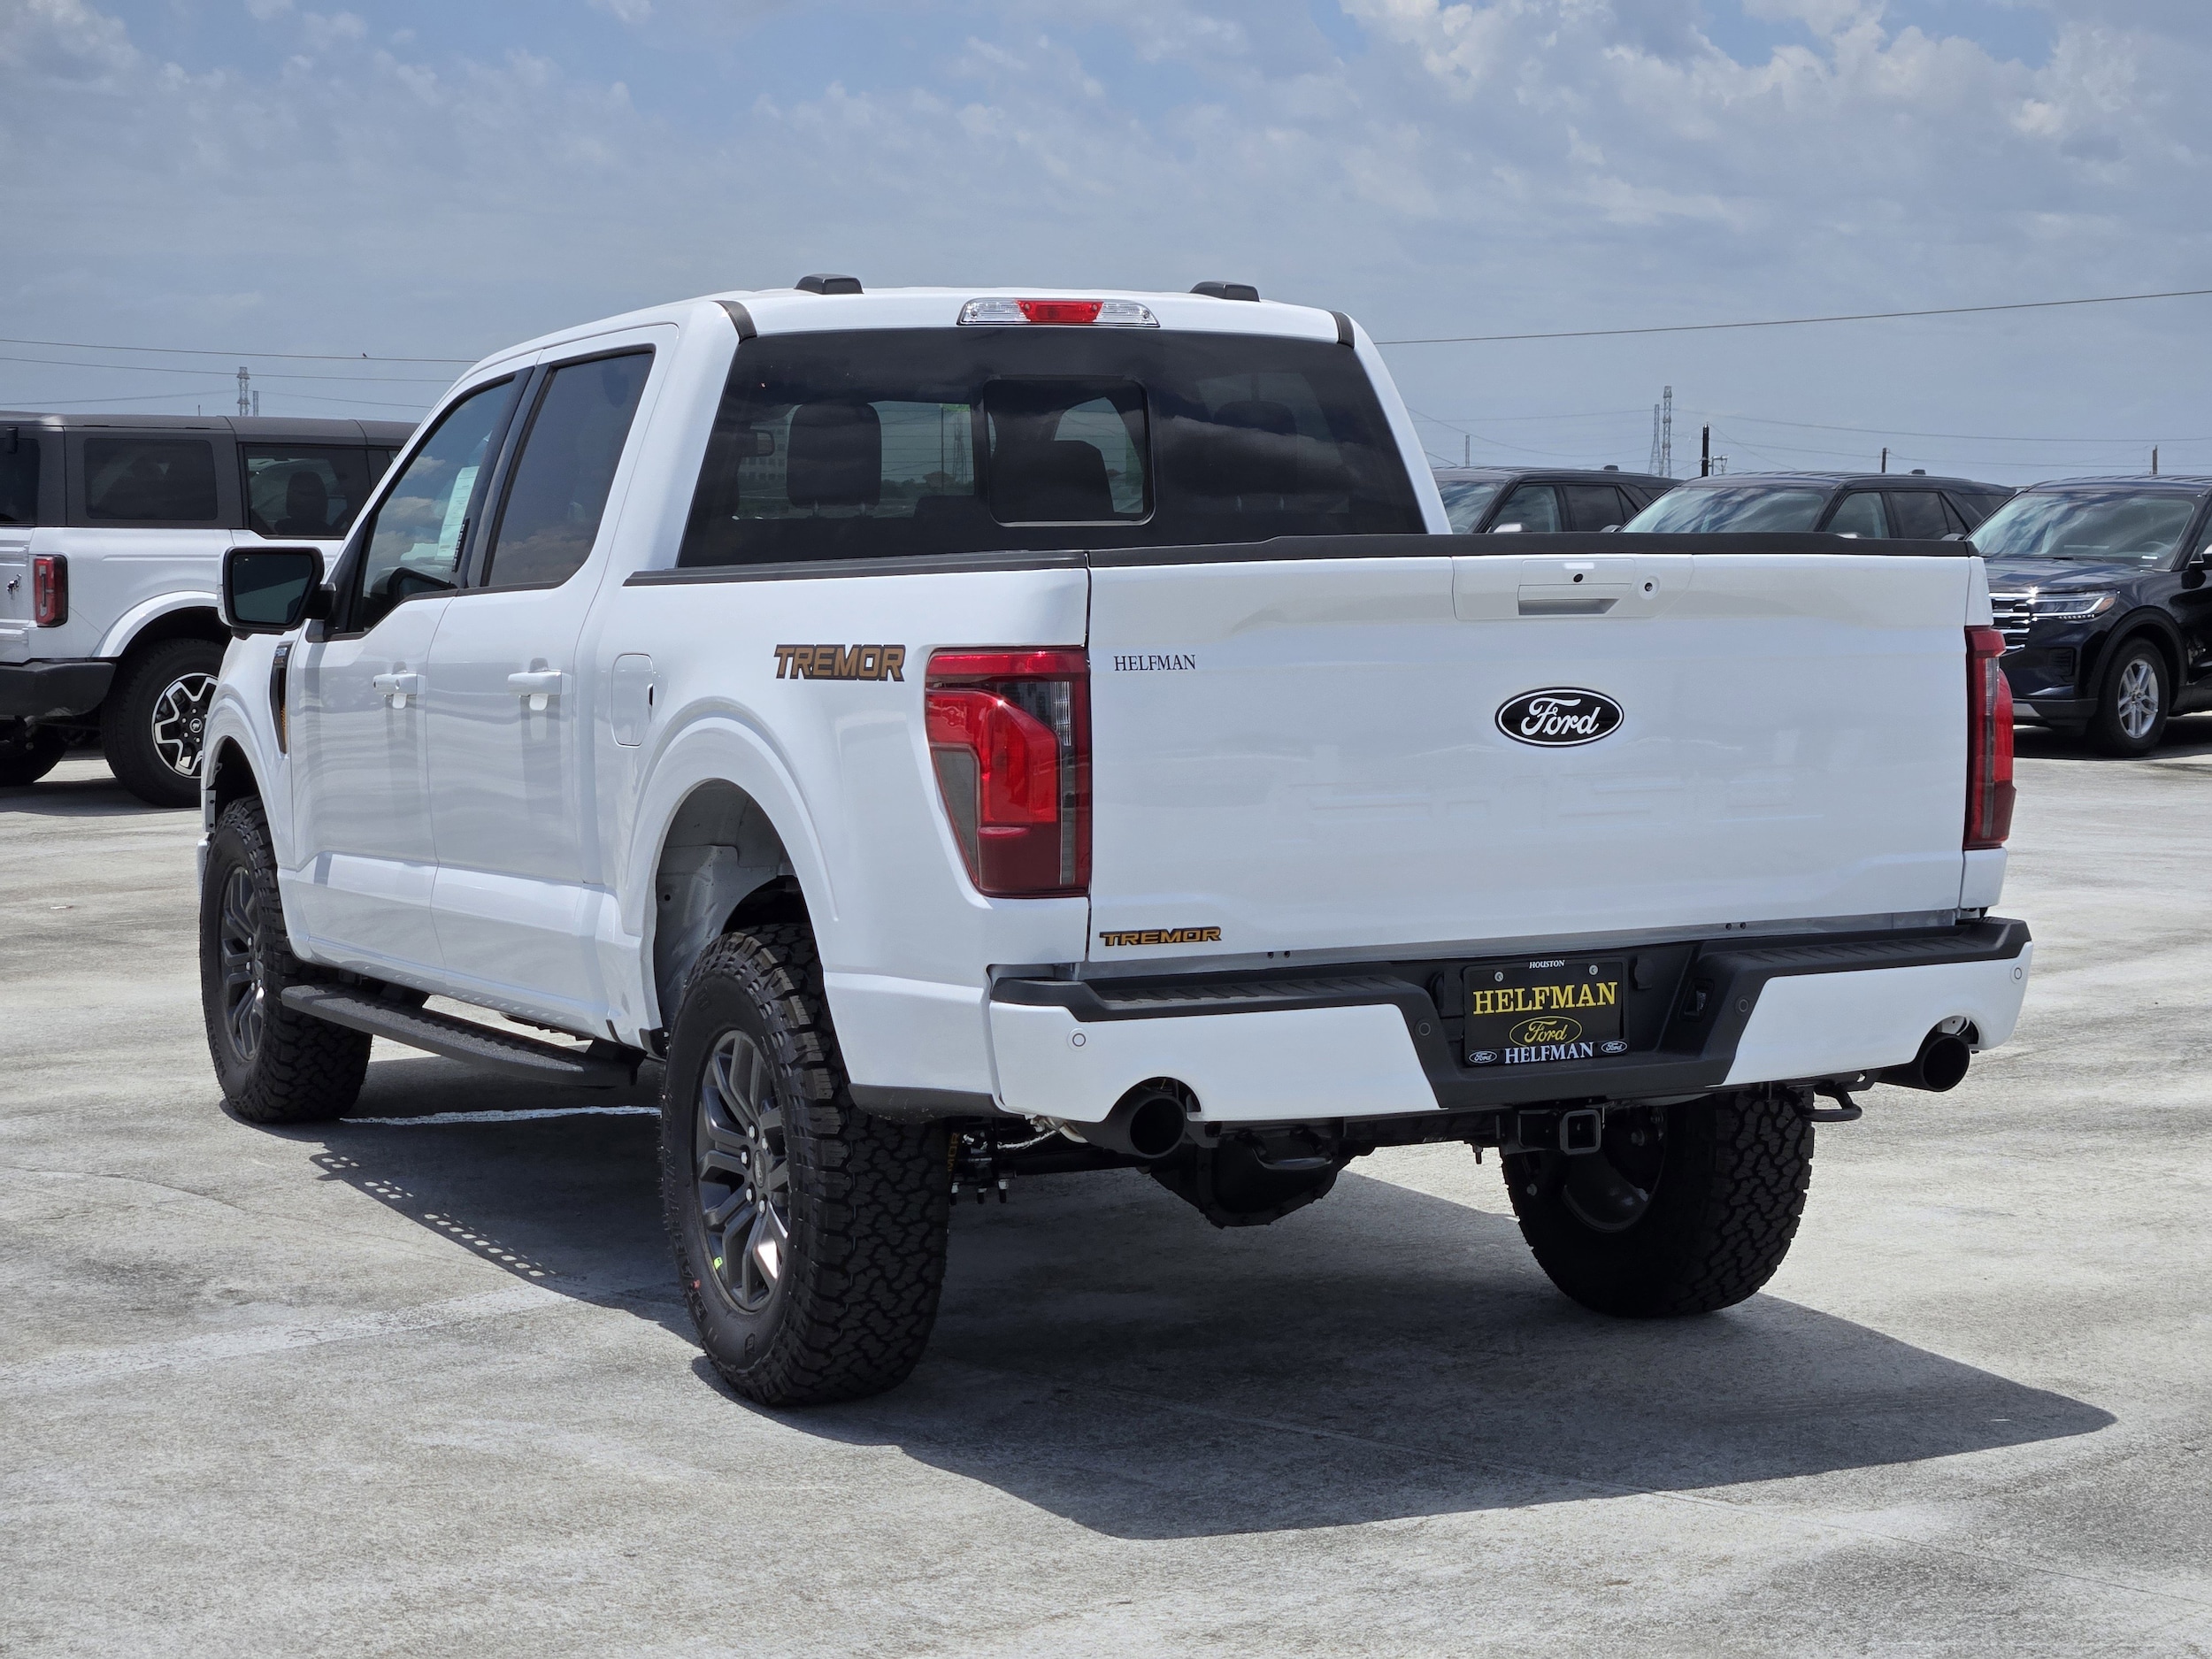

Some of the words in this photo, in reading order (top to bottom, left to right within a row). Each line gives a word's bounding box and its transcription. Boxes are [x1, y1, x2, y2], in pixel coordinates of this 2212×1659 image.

[772, 644, 906, 682] TREMOR
[1113, 653, 1197, 672] HELFMAN
[1520, 697, 1601, 736] Ford
[1098, 926, 1223, 948] TREMOR
[1528, 959, 1565, 970] HOUSTON
[1472, 981, 1618, 1015] HELFMAN
[1524, 1020, 1569, 1043] Ford
[1504, 1041, 1594, 1064] HELFMAN
